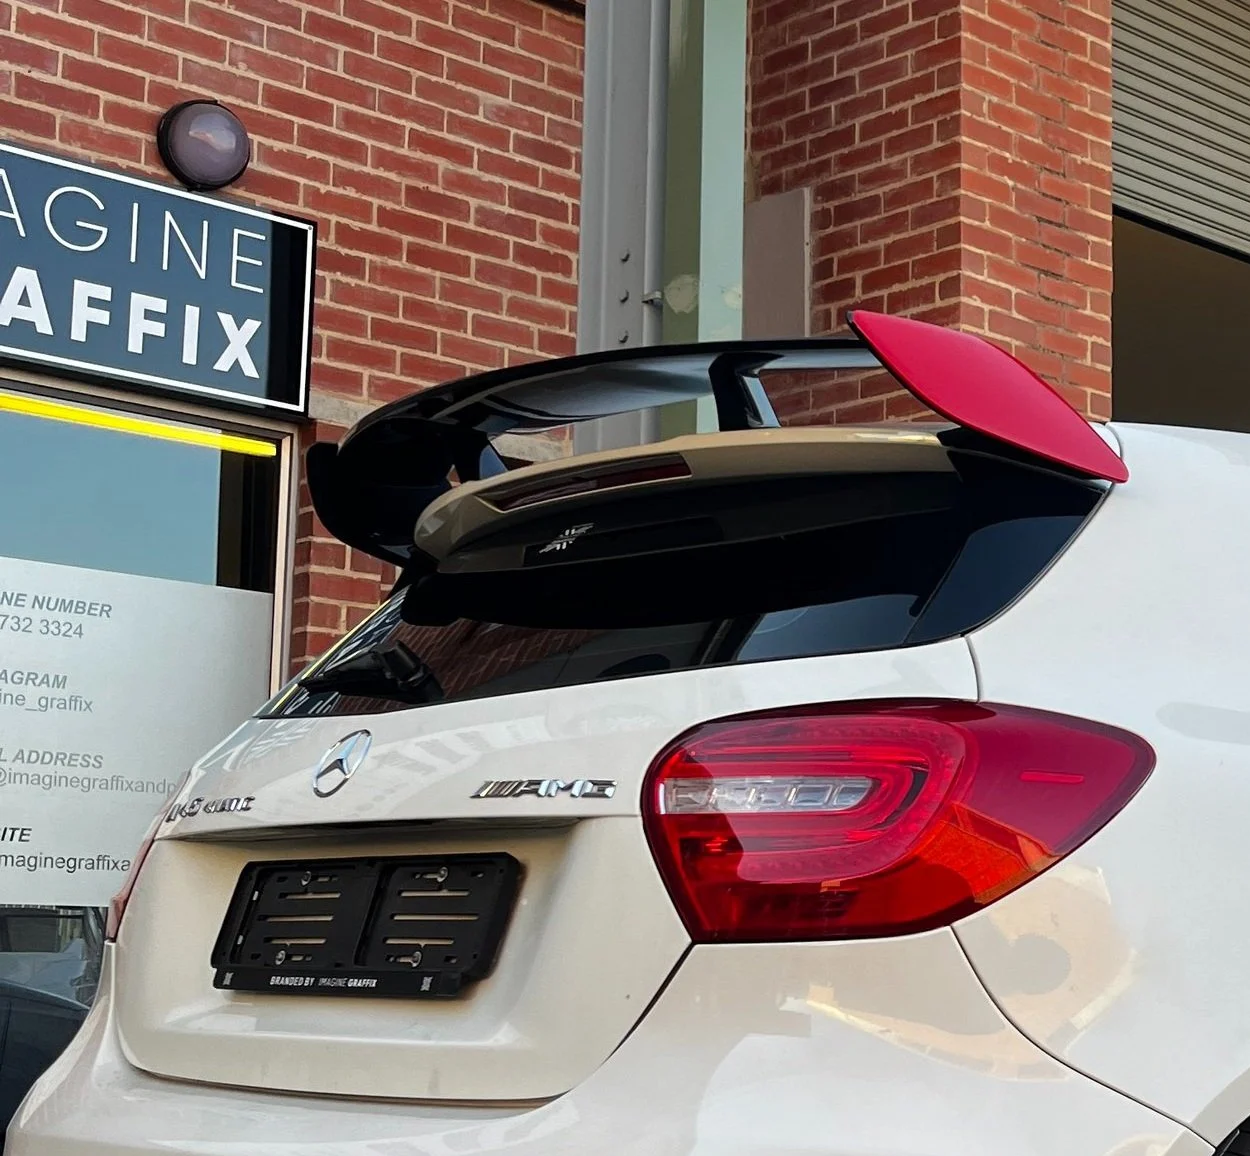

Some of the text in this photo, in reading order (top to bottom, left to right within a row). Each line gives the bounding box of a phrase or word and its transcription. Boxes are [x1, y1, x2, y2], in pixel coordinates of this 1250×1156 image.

[0, 266, 262, 379] AFFIX
[32, 595, 113, 618] NUMBER
[0, 614, 84, 639] 732 3324
[0, 669, 68, 689] AGRAM
[12, 749, 104, 769] ADDRESS
[270, 976, 303, 986] BRANDED
[304, 976, 315, 986] BY
[347, 978, 377, 988] GRAFFIX
